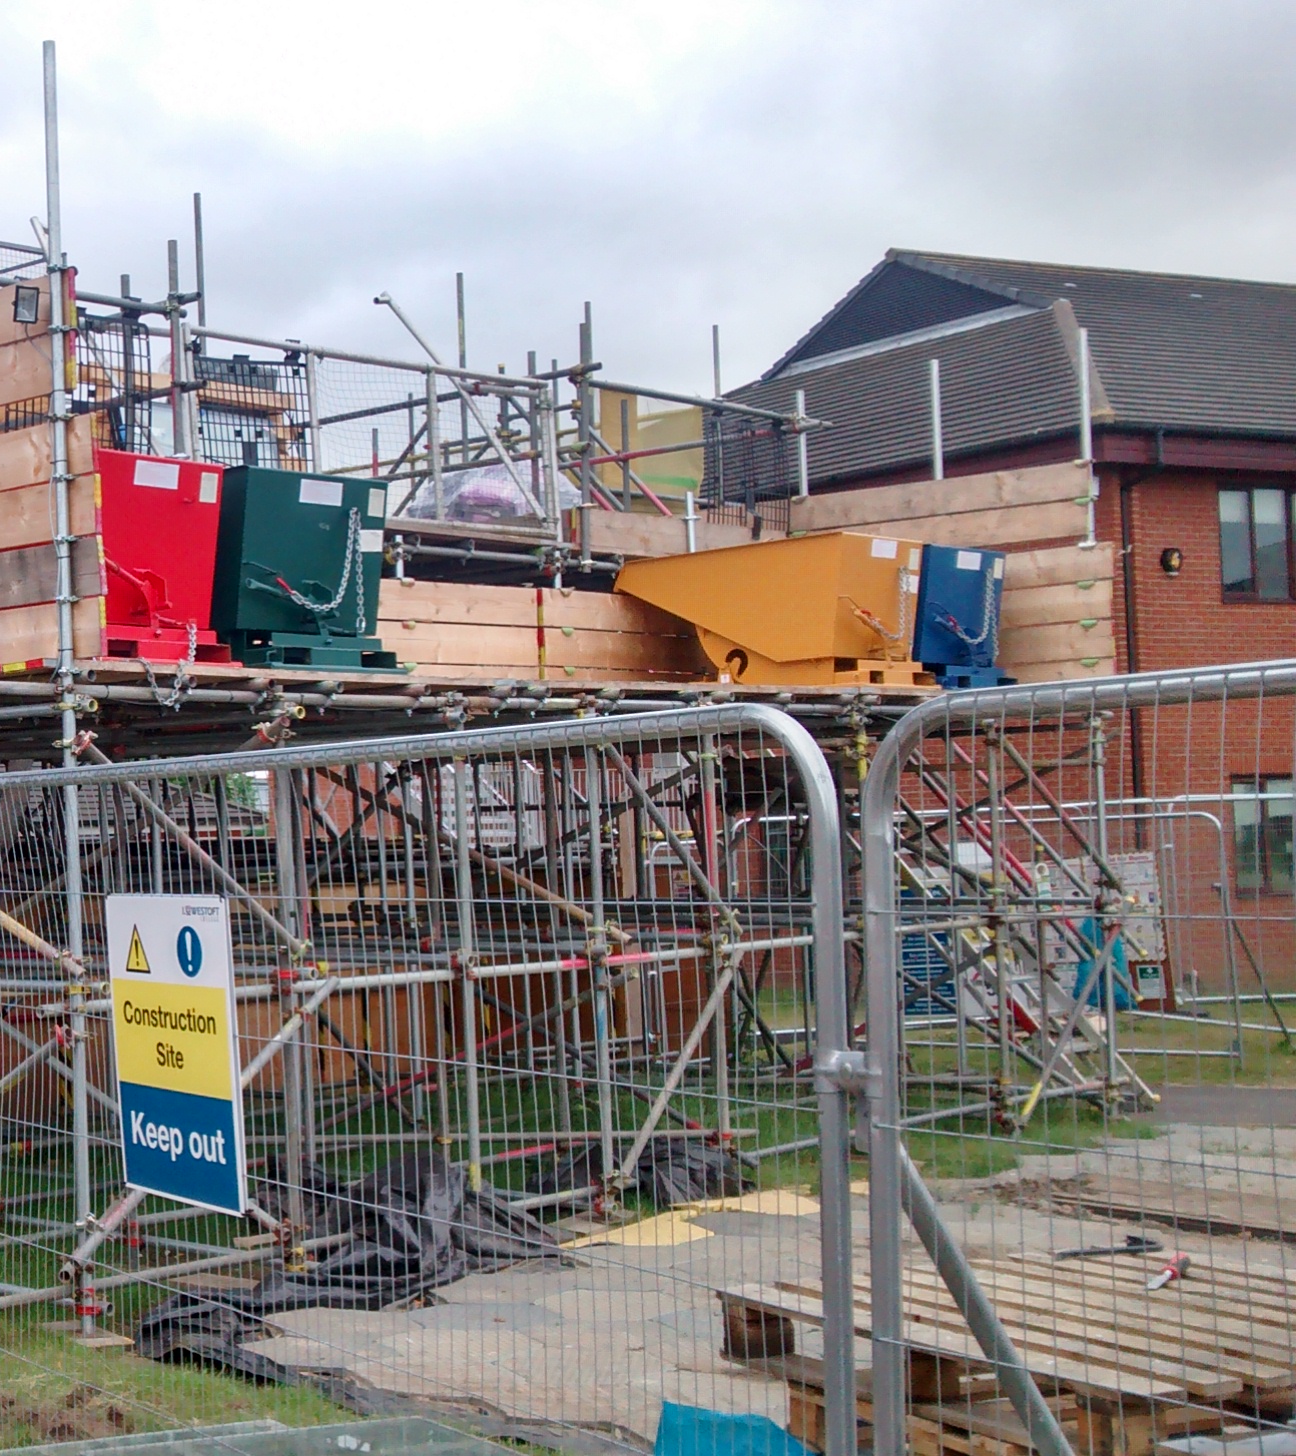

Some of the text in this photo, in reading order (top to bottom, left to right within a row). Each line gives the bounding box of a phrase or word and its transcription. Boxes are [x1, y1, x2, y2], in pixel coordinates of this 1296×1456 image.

[123, 1000, 217, 1035] Construction
[156, 1041, 184, 1070] Site
[130, 1110, 227, 1165] Keep out
